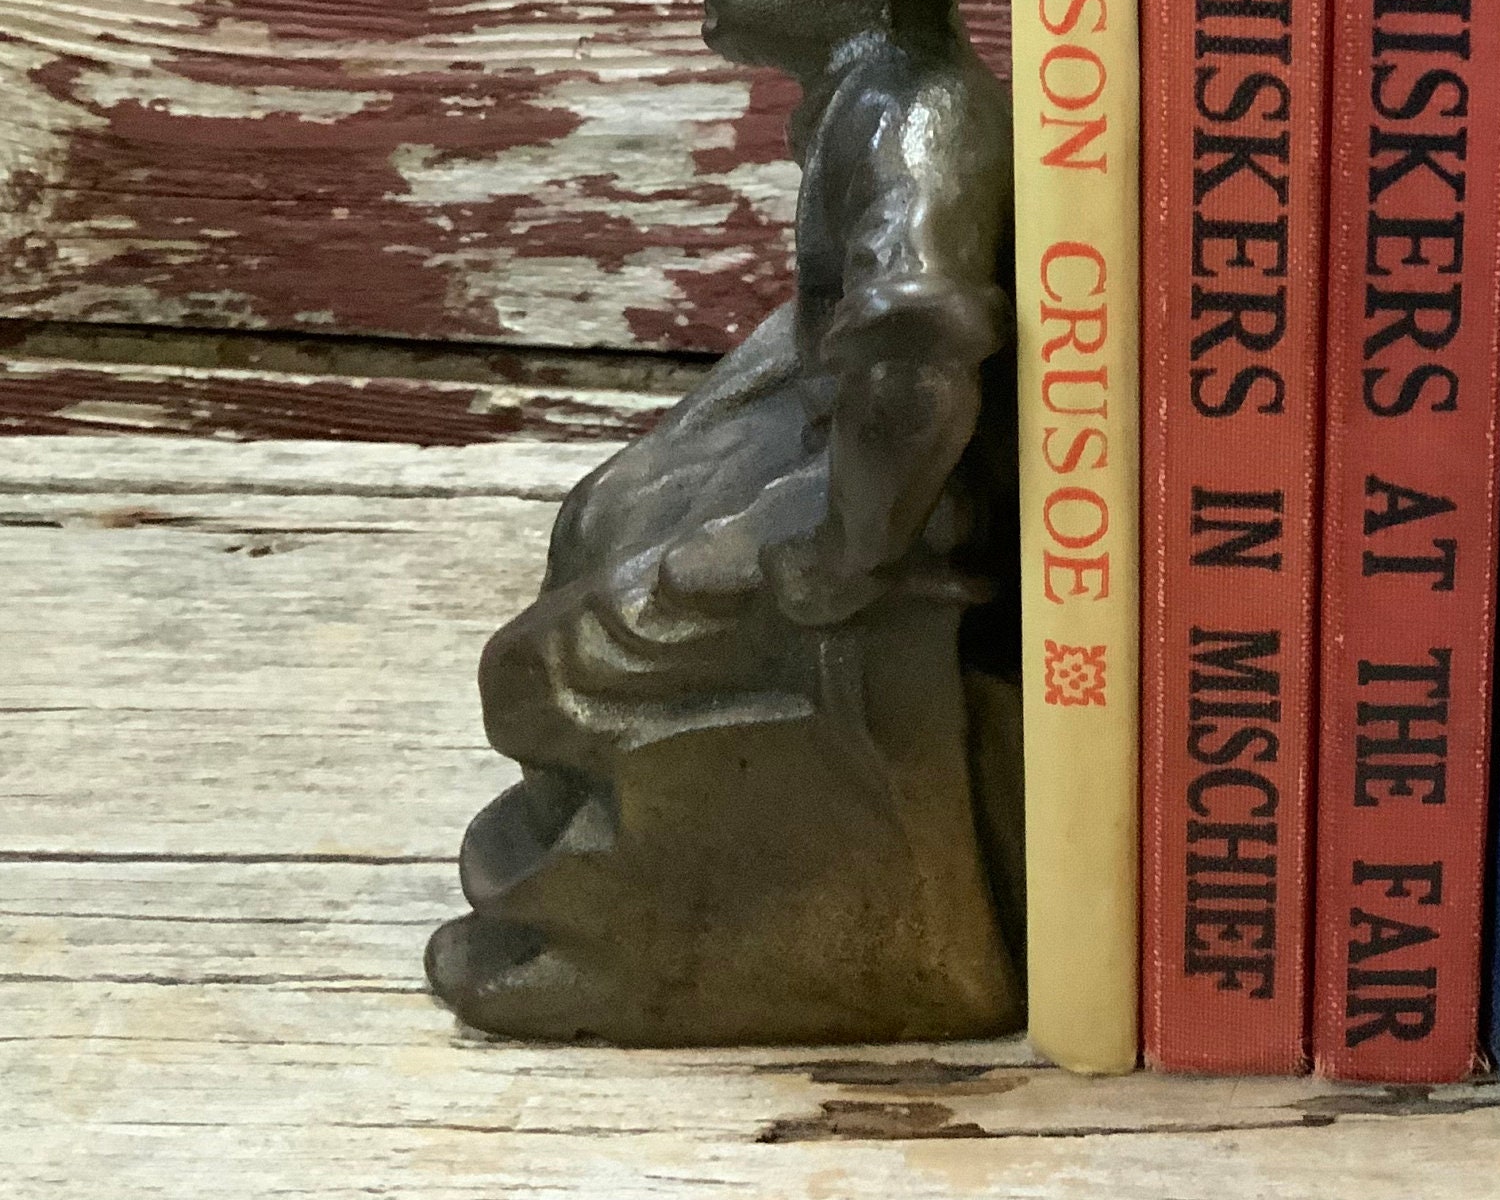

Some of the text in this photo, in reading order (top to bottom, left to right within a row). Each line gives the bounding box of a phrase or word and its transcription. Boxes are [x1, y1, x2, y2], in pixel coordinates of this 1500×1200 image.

[1039, 241, 1110, 605] CRUSOE
[1188, 485, 1285, 573] IN
[1361, 473, 1458, 592] AT
[1183, 625, 1282, 1000] MISCHIEF
[1353, 647, 1453, 808] THE
[1344, 860, 1443, 1049] FAIR
